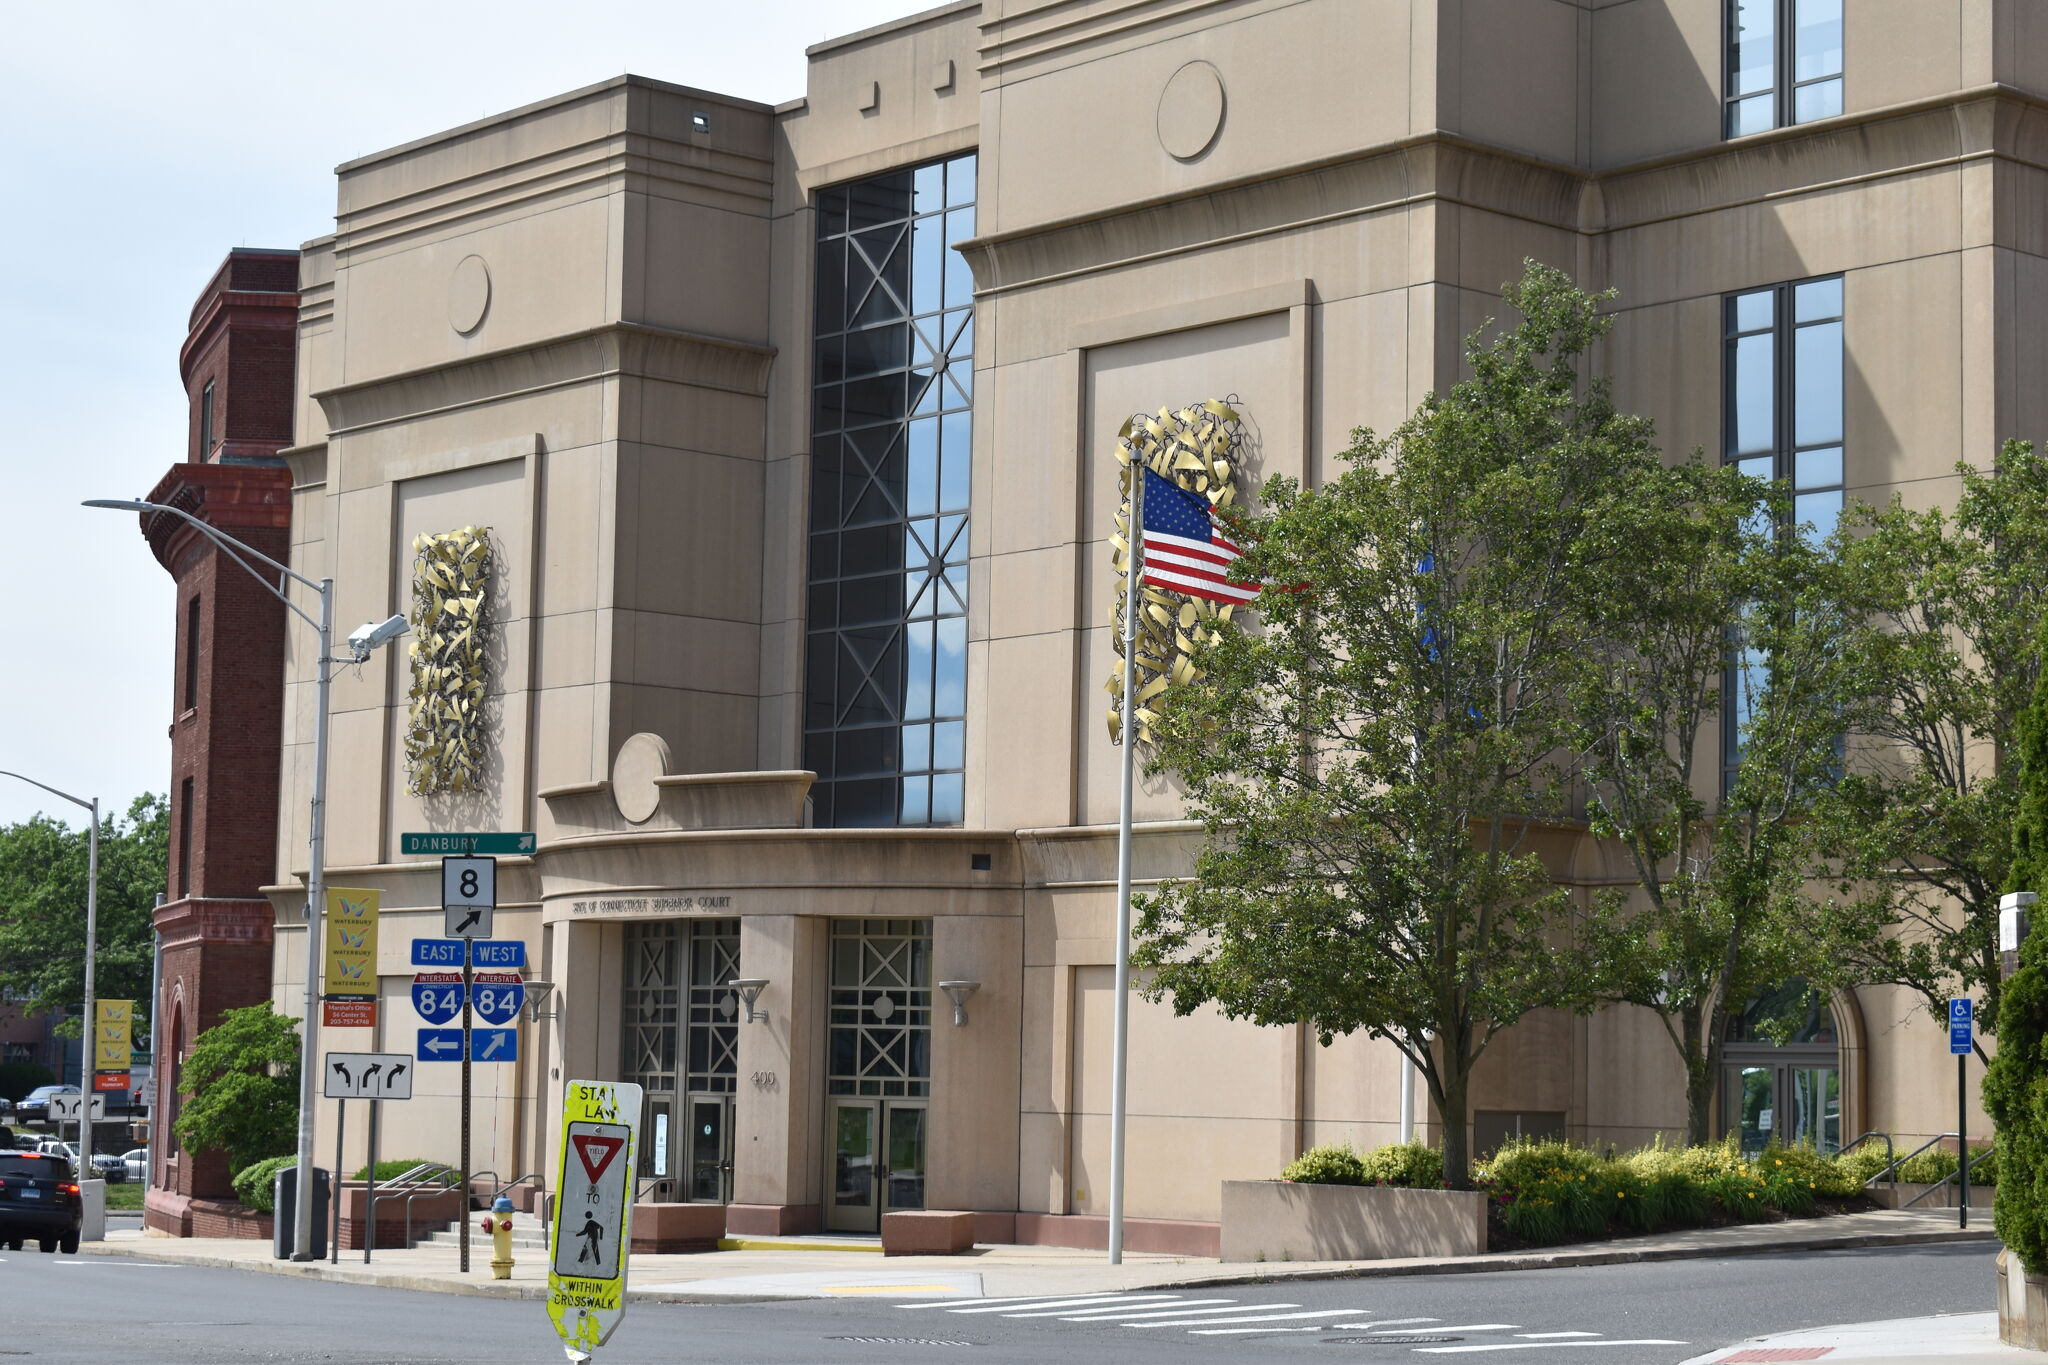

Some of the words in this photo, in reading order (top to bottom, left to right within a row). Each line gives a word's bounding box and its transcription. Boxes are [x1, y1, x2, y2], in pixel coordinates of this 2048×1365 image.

[411, 837, 479, 850] DANBURY
[460, 869, 479, 898] 8
[652, 897, 693, 909] SUPERIOR
[697, 895, 732, 909] COURT
[420, 945, 456, 961] EAST
[479, 946, 518, 962] WEST
[480, 975, 516, 983] INTERSTATE
[419, 990, 457, 1015] 84
[479, 990, 516, 1015] 84
[750, 1070, 775, 1085] 400
[590, 1147, 605, 1155] YIELD
[586, 1193, 600, 1205] TO
[568, 1280, 603, 1294] WITHIN
[554, 1294, 614, 1310] CROSSWALK
